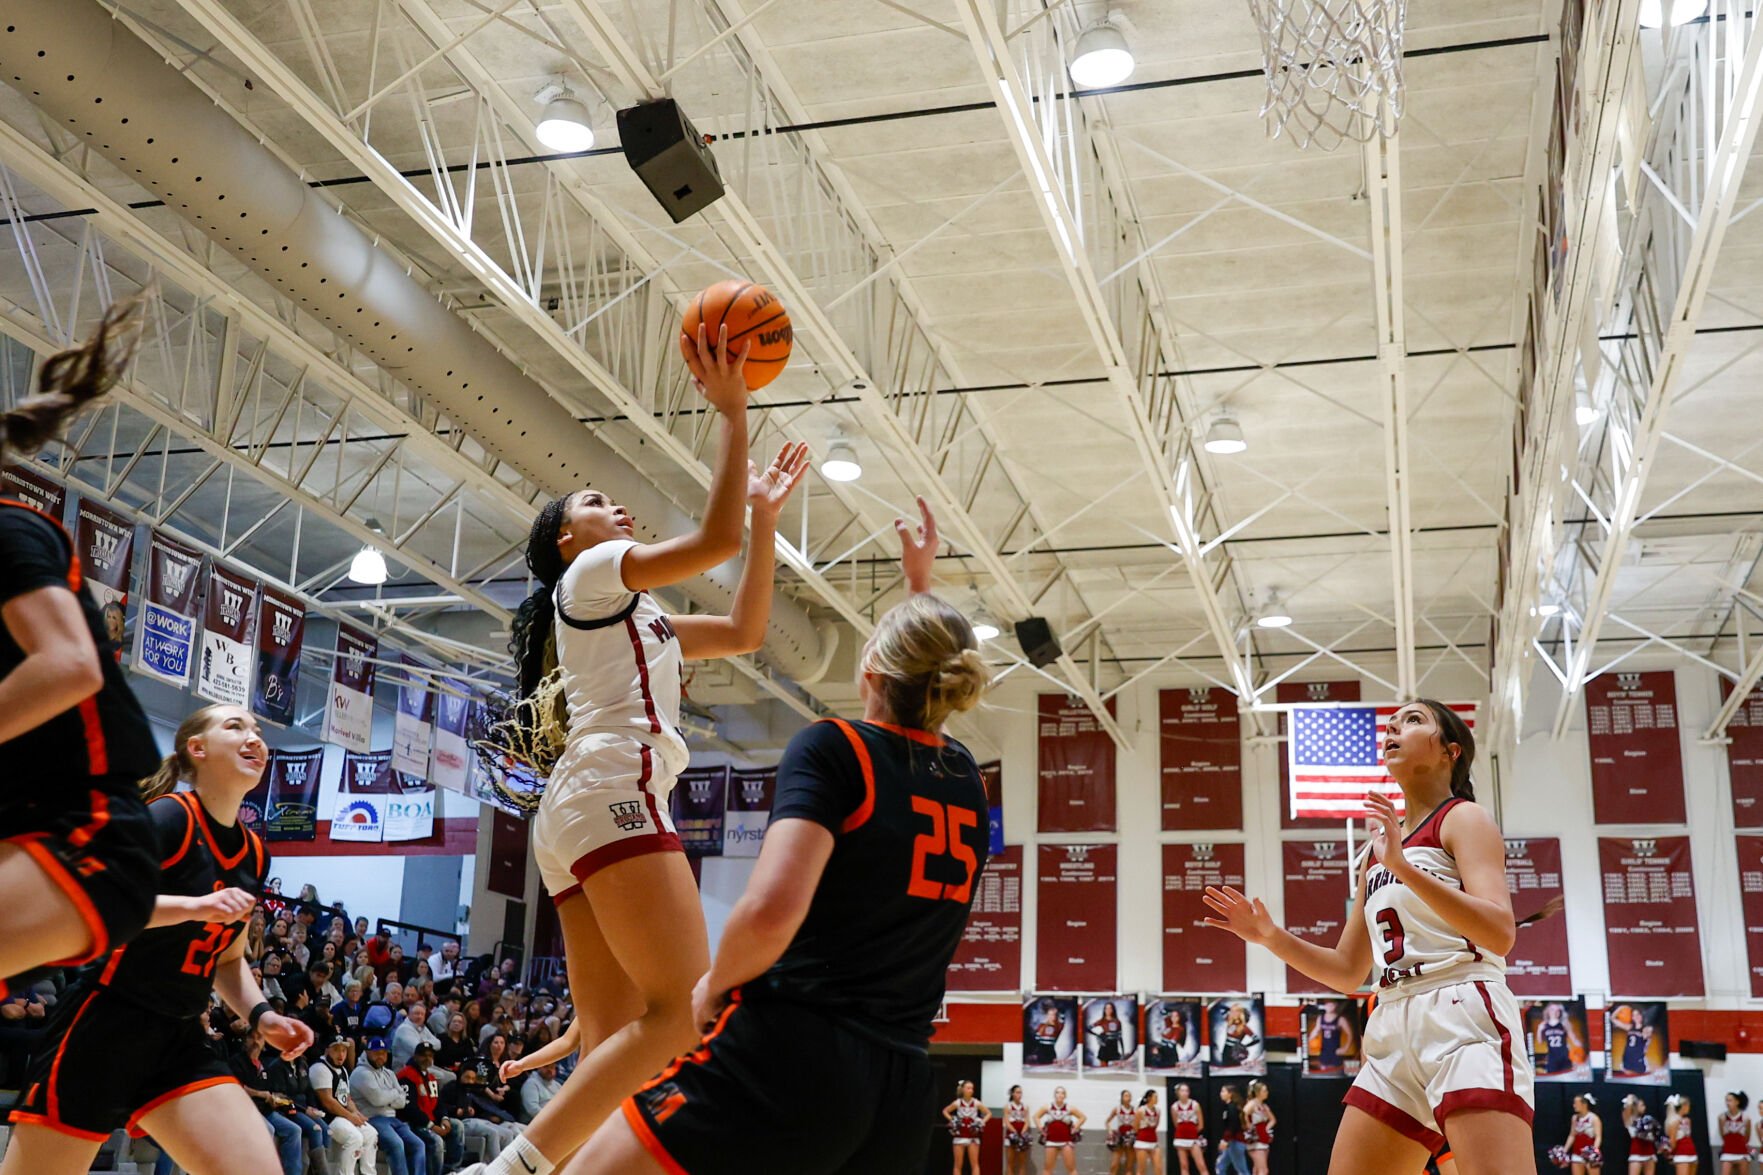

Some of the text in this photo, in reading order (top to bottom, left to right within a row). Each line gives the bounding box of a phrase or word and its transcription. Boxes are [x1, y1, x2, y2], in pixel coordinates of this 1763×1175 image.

[146, 610, 188, 636] @WORK
[144, 648, 183, 672] FOR YOU
[145, 636, 185, 660] AT WORK
[388, 801, 432, 818] BOA
[727, 828, 764, 843] nyrst
[907, 795, 978, 904] 25
[1376, 907, 1405, 966] 3
[181, 921, 235, 978] 21
